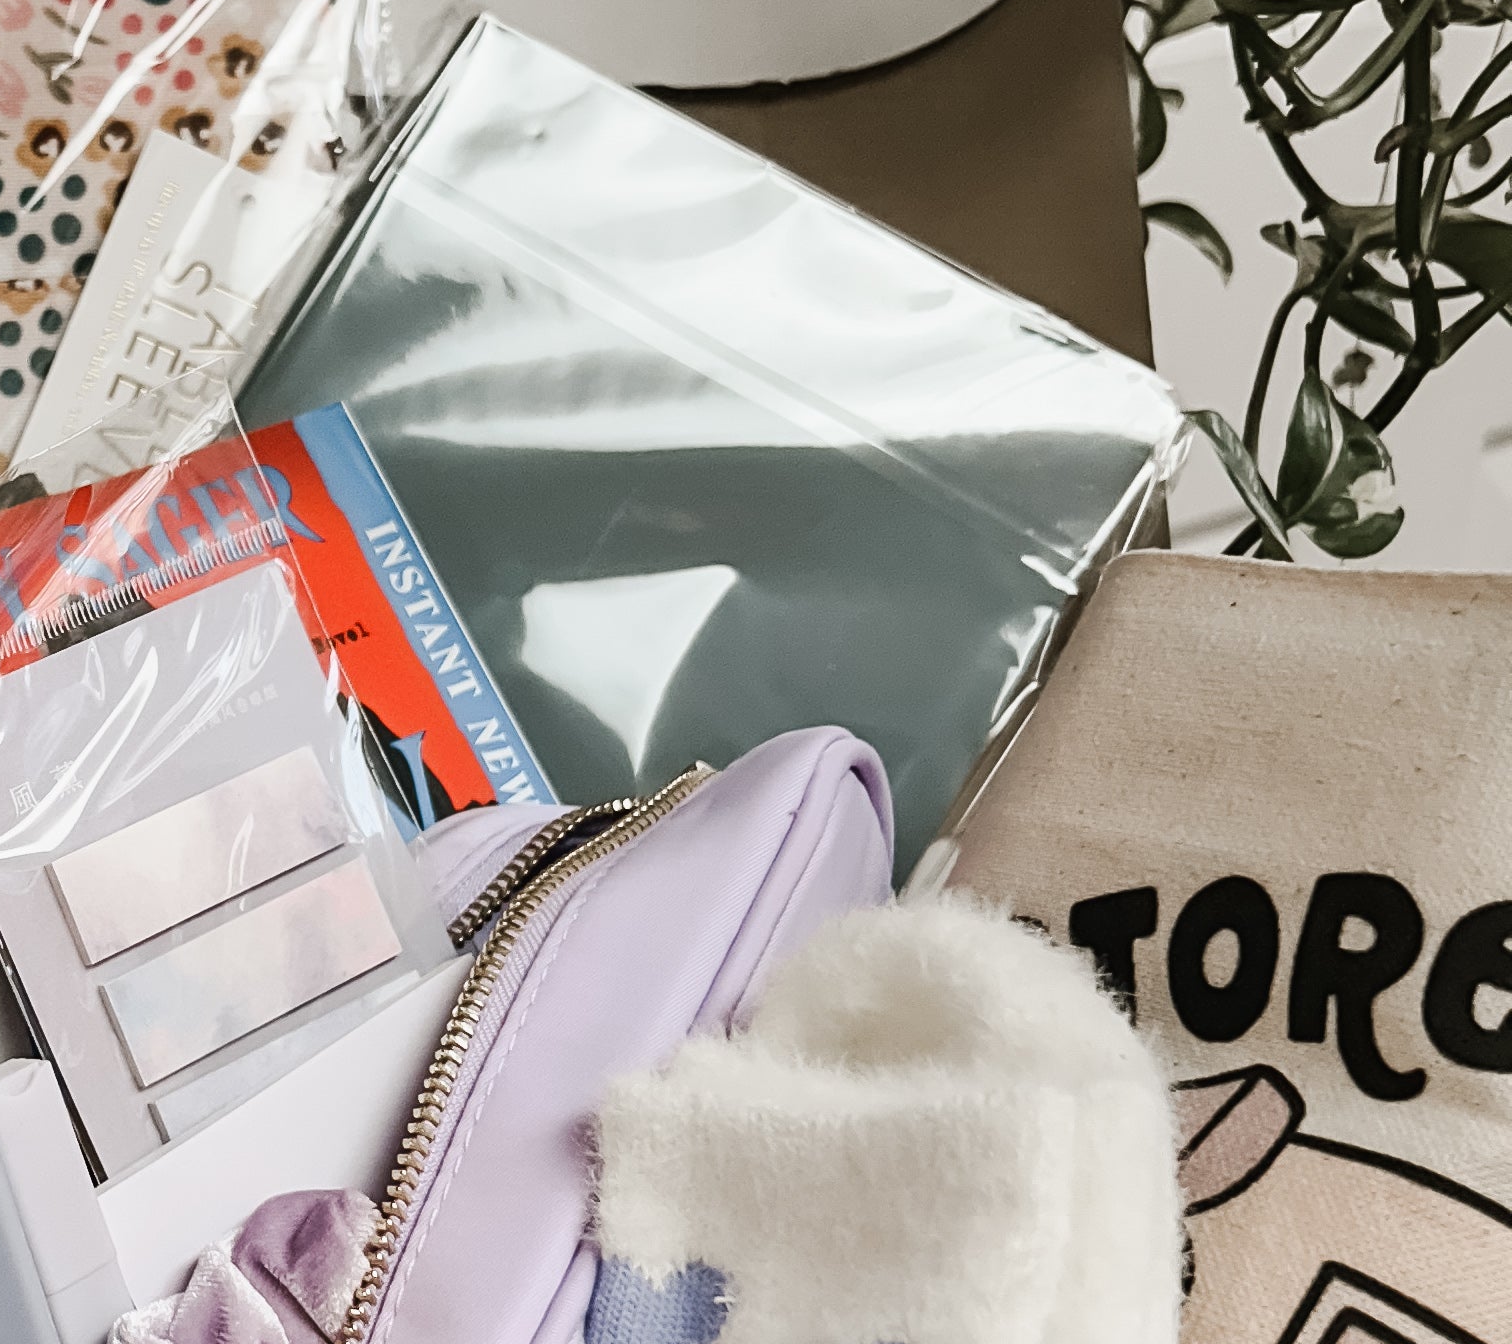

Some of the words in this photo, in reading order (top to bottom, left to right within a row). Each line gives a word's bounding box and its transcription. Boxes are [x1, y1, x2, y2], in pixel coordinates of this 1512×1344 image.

[55, 463, 326, 601] SAGER
[365, 520, 483, 699] INSTANT
[467, 717, 540, 806] NEW
